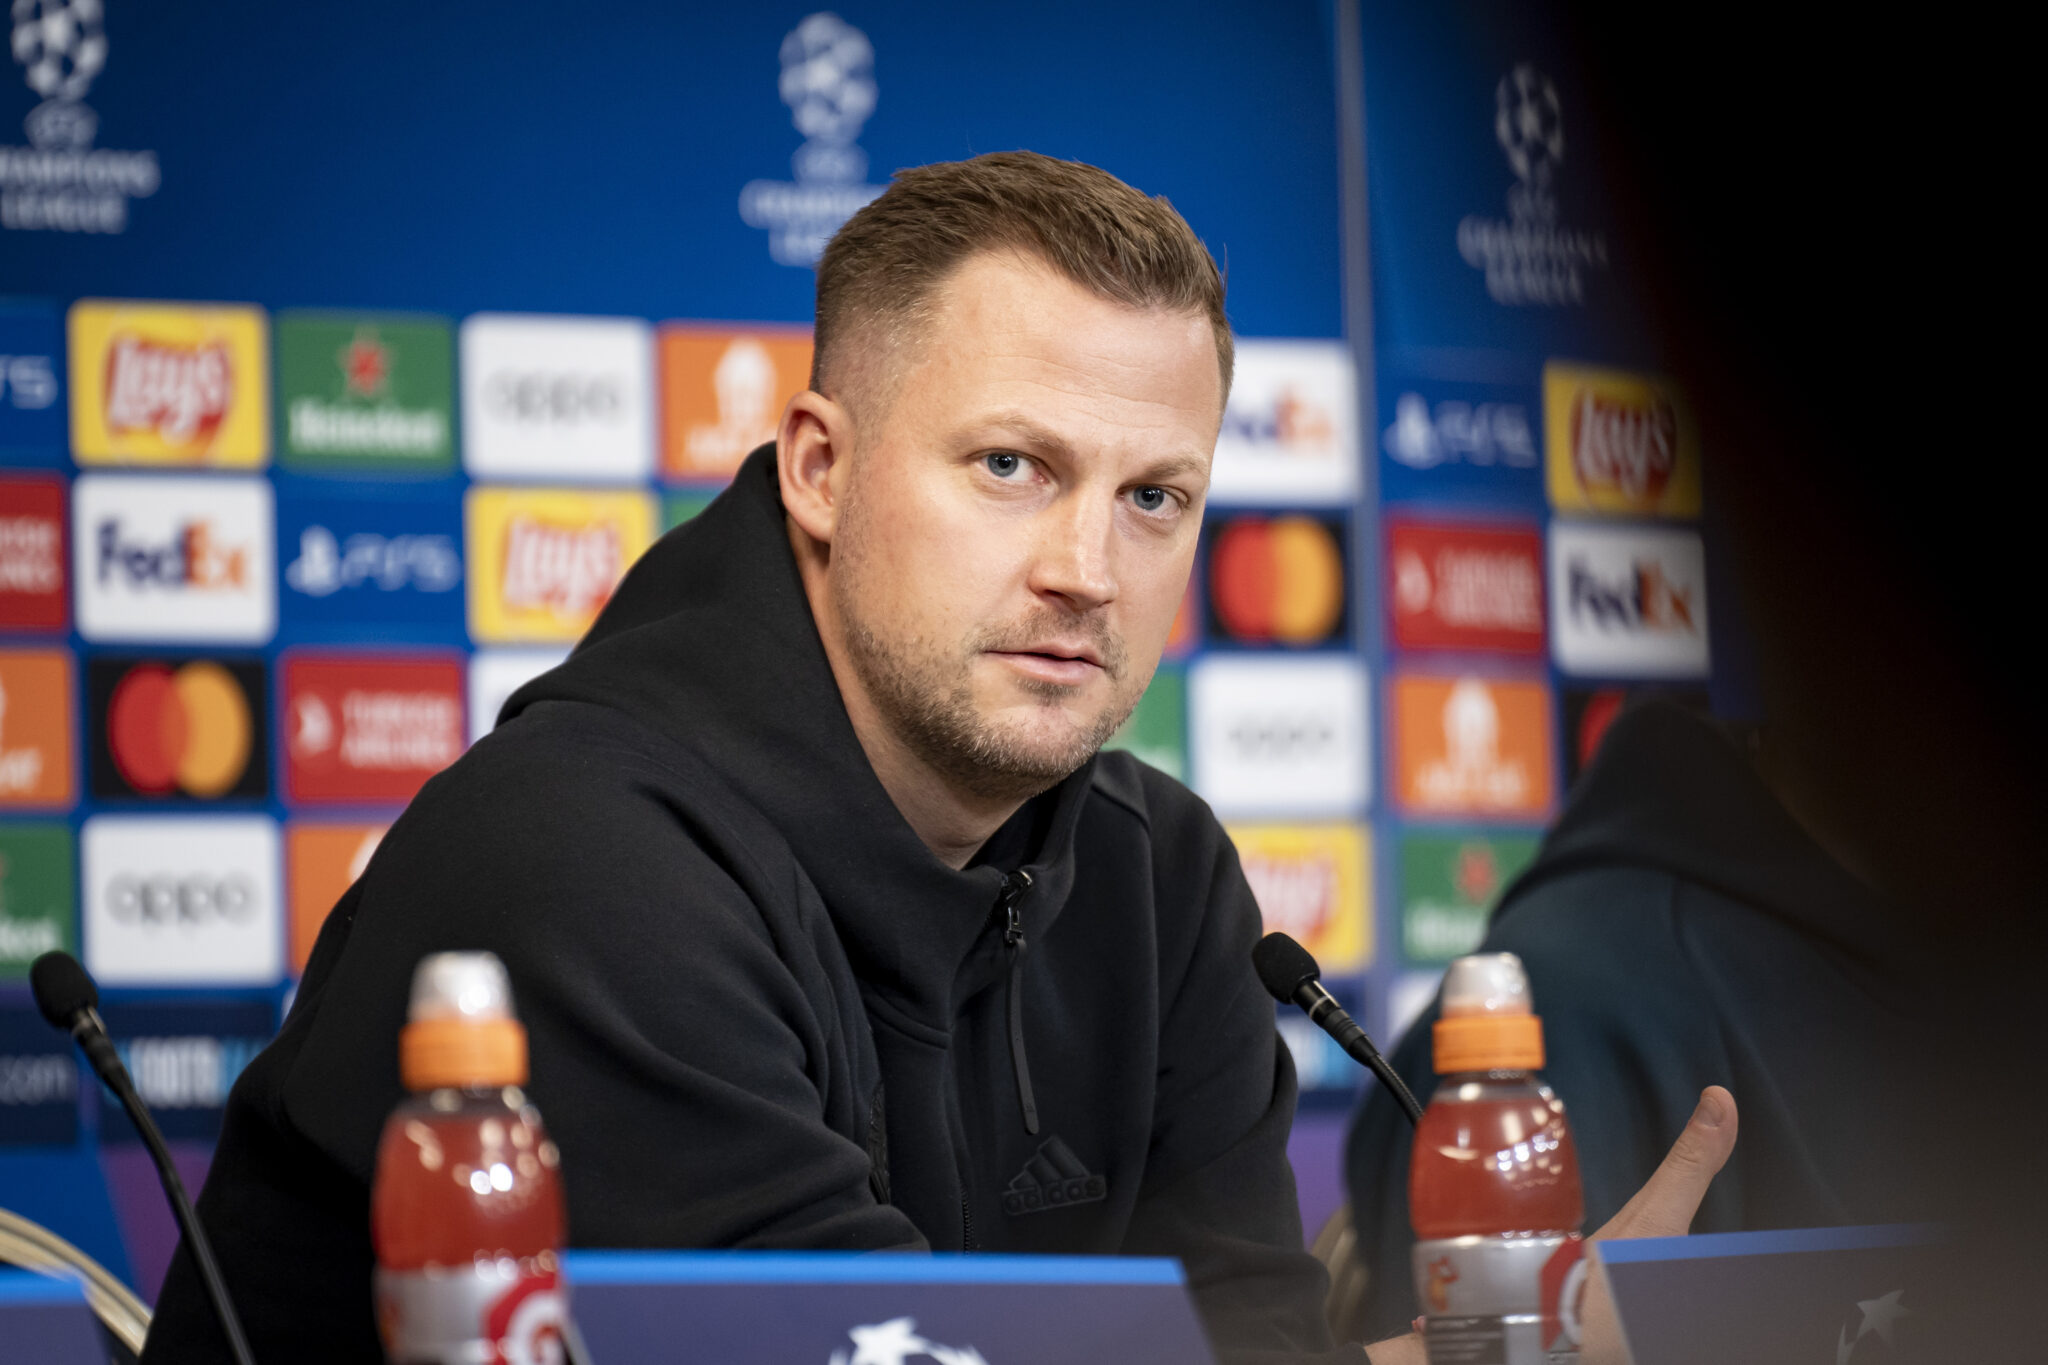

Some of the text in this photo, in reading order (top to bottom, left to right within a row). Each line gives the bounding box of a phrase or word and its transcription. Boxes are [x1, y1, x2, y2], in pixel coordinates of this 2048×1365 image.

[288, 398, 448, 458] Heineken
[96, 517, 250, 594] FedEx
[1566, 555, 1698, 638] FedEx
[104, 870, 262, 942] oppo
[1003, 1175, 1106, 1214] adidas
